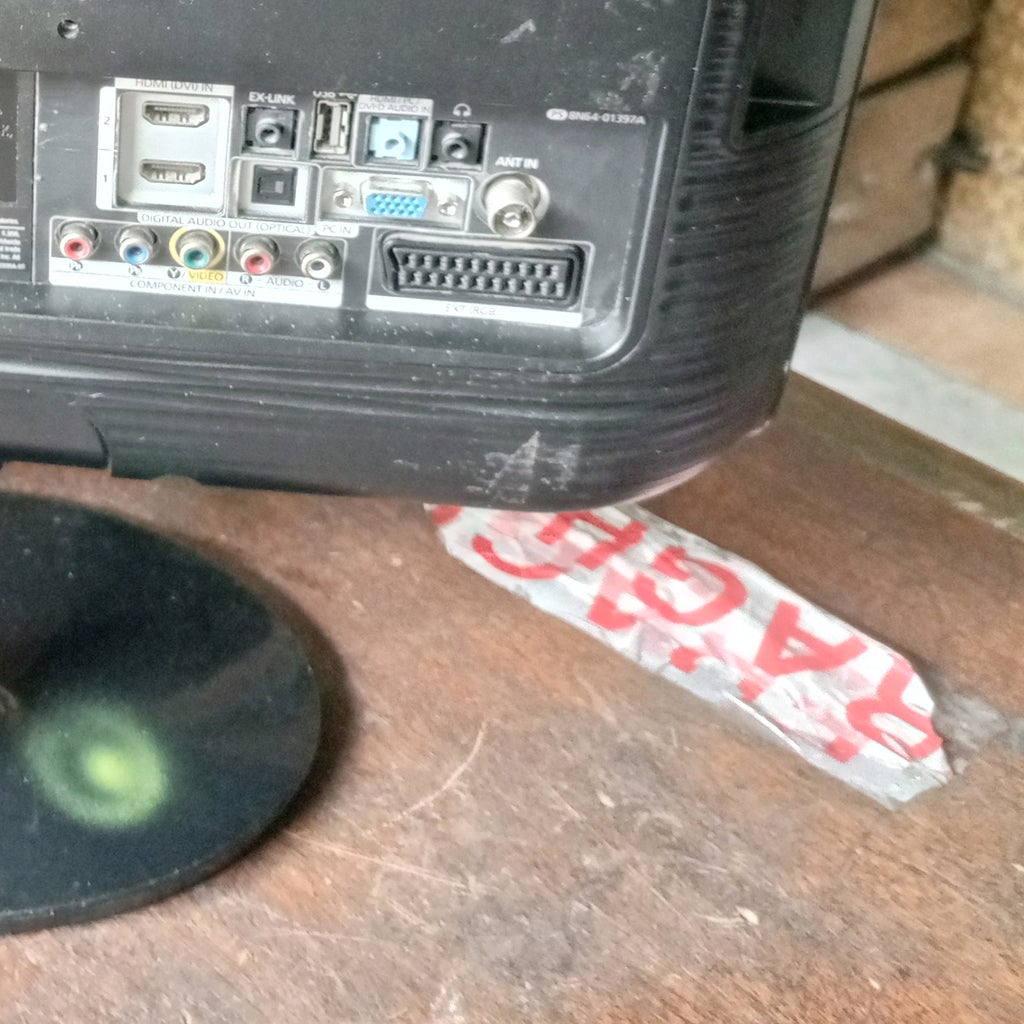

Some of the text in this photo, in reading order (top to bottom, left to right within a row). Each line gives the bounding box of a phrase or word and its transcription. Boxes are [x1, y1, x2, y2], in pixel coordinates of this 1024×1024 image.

[135, 79, 213, 92] HDMI (DVI) IN
[248, 91, 295, 105] EX-LINK
[387, 104, 417, 113] AUDIO
[103, 117, 110, 125] 2
[495, 156, 538, 169] ANT IN
[141, 215, 311, 234] DIGITAL AUDIO OUT (OPTICAL)
[323, 225, 351, 234] PC IN
[188, 271, 224, 281] VIDEO
[130, 280, 200, 294] COMPONENT
[202, 285, 217, 295] IN
[225, 288, 242, 297] AV
[243, 289, 256, 297] IN
[266, 278, 304, 288] AUDIO
